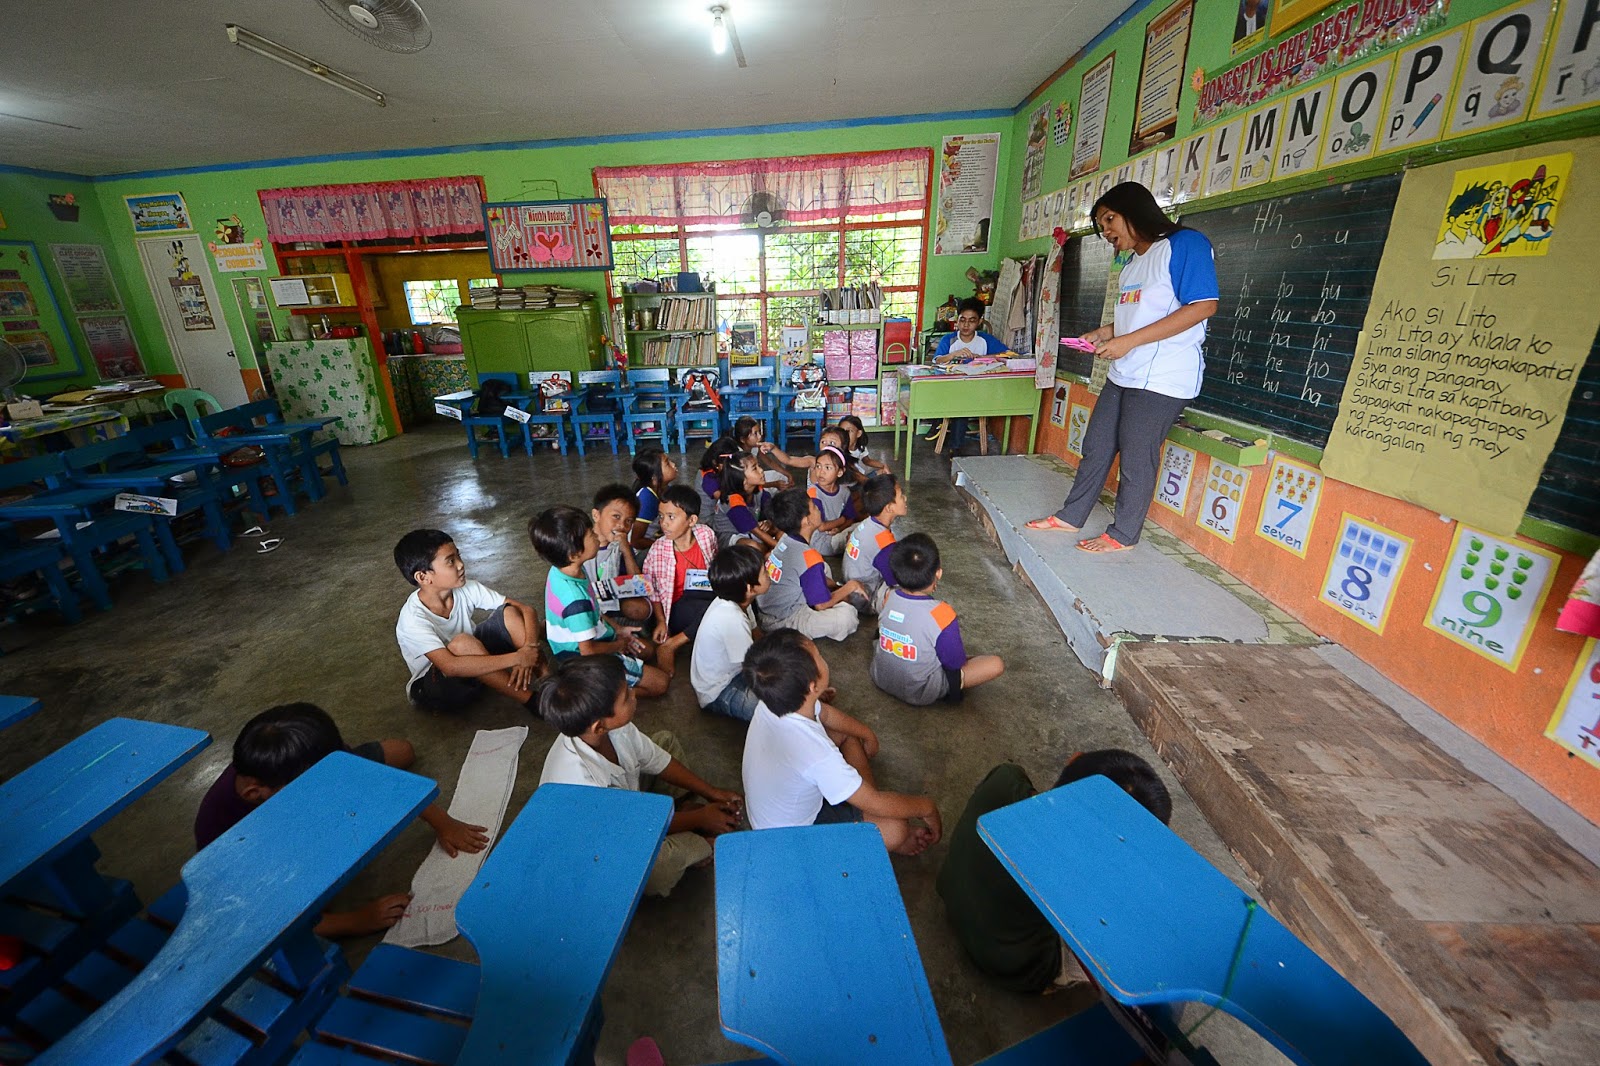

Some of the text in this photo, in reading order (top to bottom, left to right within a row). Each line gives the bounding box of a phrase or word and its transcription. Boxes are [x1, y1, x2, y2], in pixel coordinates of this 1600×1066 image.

[1198, 58, 1258, 112] HONESTY
[1256, 46, 1276, 86] IS
[1272, 32, 1309, 77] THE
[1307, 4, 1360, 60] BEST
[1477, 13, 1531, 74] Q
[1403, 45, 1443, 105] P
[1556, 72, 1573, 95] r
[1341, 71, 1377, 123] O
[1464, 91, 1482, 117] q
[1288, 91, 1321, 142] N
[1389, 113, 1404, 138] p
[1215, 127, 1230, 165] L
[1245, 108, 1277, 155] M
[1331, 137, 1342, 153] o
[1161, 148, 1175, 182] J
[1184, 135, 1204, 174] K
[1281, 153, 1290, 169] n
[1240, 164, 1251, 179] m
[1043, 197, 1051, 218] C
[1053, 193, 1063, 215] D
[1067, 187, 1077, 211] E
[547, 210, 567, 222] Updates
[1290, 233, 1302, 249] o
[1334, 230, 1349, 245] u
[225, 258, 256, 269] CORNER
[1431, 265, 1518, 288] Si Lita
[1277, 271, 1294, 298] ho
[1320, 271, 1341, 300] hu
[1234, 298, 1336, 325] ha hu ho
[1380, 300, 1417, 323] Ako
[1455, 301, 1497, 329] Lito
[1232, 319, 1252, 343] hu
[1312, 326, 1332, 351] hi
[1371, 323, 1553, 355] Si Lita ay kilala ko
[1230, 341, 1329, 379] hi he ho
[1367, 340, 1576, 382] Lima silang magkakapatid
[1227, 362, 1322, 408] he hu ha
[1361, 357, 1512, 400] Siya ang panganay
[1051, 416, 1062, 425] one
[1054, 401, 1062, 418] 1
[1350, 388, 1528, 442] Sapagkat nakapagtapos
[1407, 381, 1435, 400] Lita
[1438, 392, 1455, 404] sa
[1460, 393, 1558, 431] kapitbahay
[1072, 427, 1081, 446] 2
[1349, 408, 1511, 460] ng pag-aaral ng may
[1163, 471, 1183, 496] 5
[1158, 491, 1180, 509] five
[1211, 495, 1229, 520] 6
[1275, 498, 1303, 529] 7
[1204, 517, 1230, 536] six
[1262, 523, 1302, 549] seven
[1340, 565, 1373, 602] 8
[1327, 588, 1378, 622] eight
[1457, 590, 1503, 628] 9
[880, 635, 917, 661] EACH
[1441, 615, 1505, 655] nine
